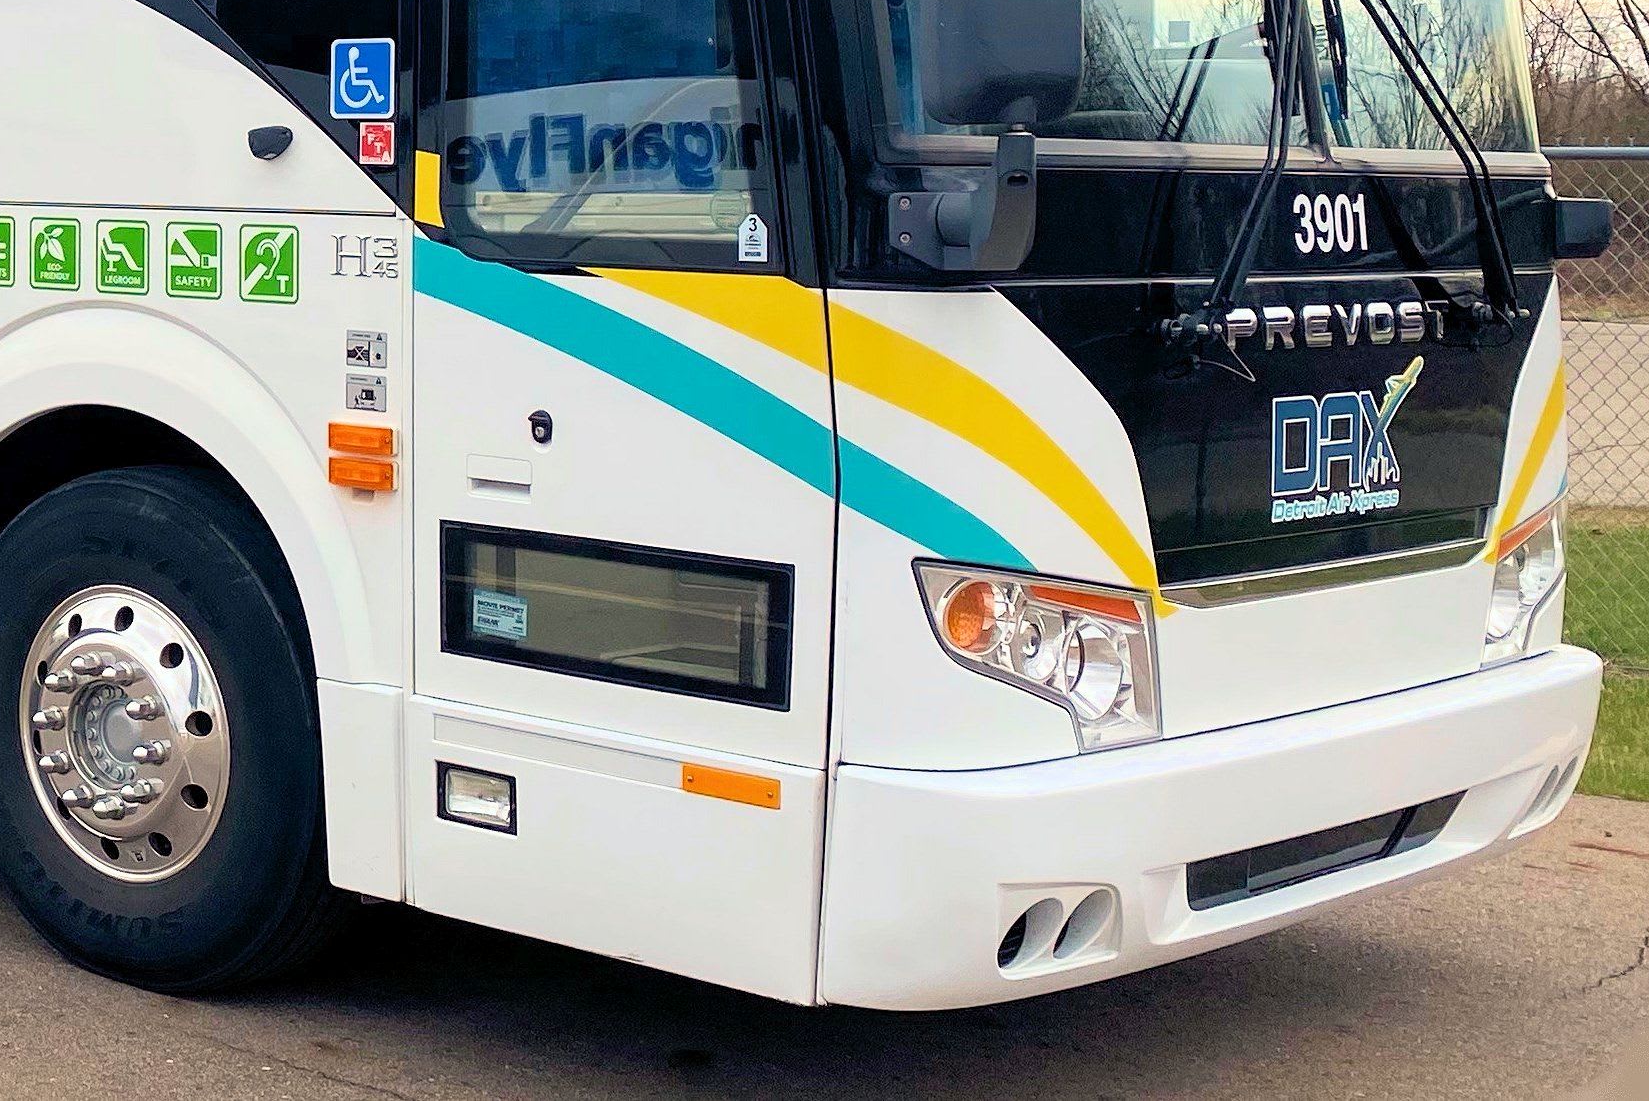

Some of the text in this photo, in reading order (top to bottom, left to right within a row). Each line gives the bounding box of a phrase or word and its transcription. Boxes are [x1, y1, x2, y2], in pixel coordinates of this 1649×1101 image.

[749, 217, 758, 232] 3
[1293, 193, 1369, 254] 3901
[39, 270, 71, 281] FRIENDLY
[104, 274, 142, 286] LEGROOM
[175, 274, 213, 288] SAFETY
[1225, 299, 1450, 351] PREVOST
[1271, 391, 1400, 497] DAX
[1272, 488, 1400, 523] Detroit Air Xpress
